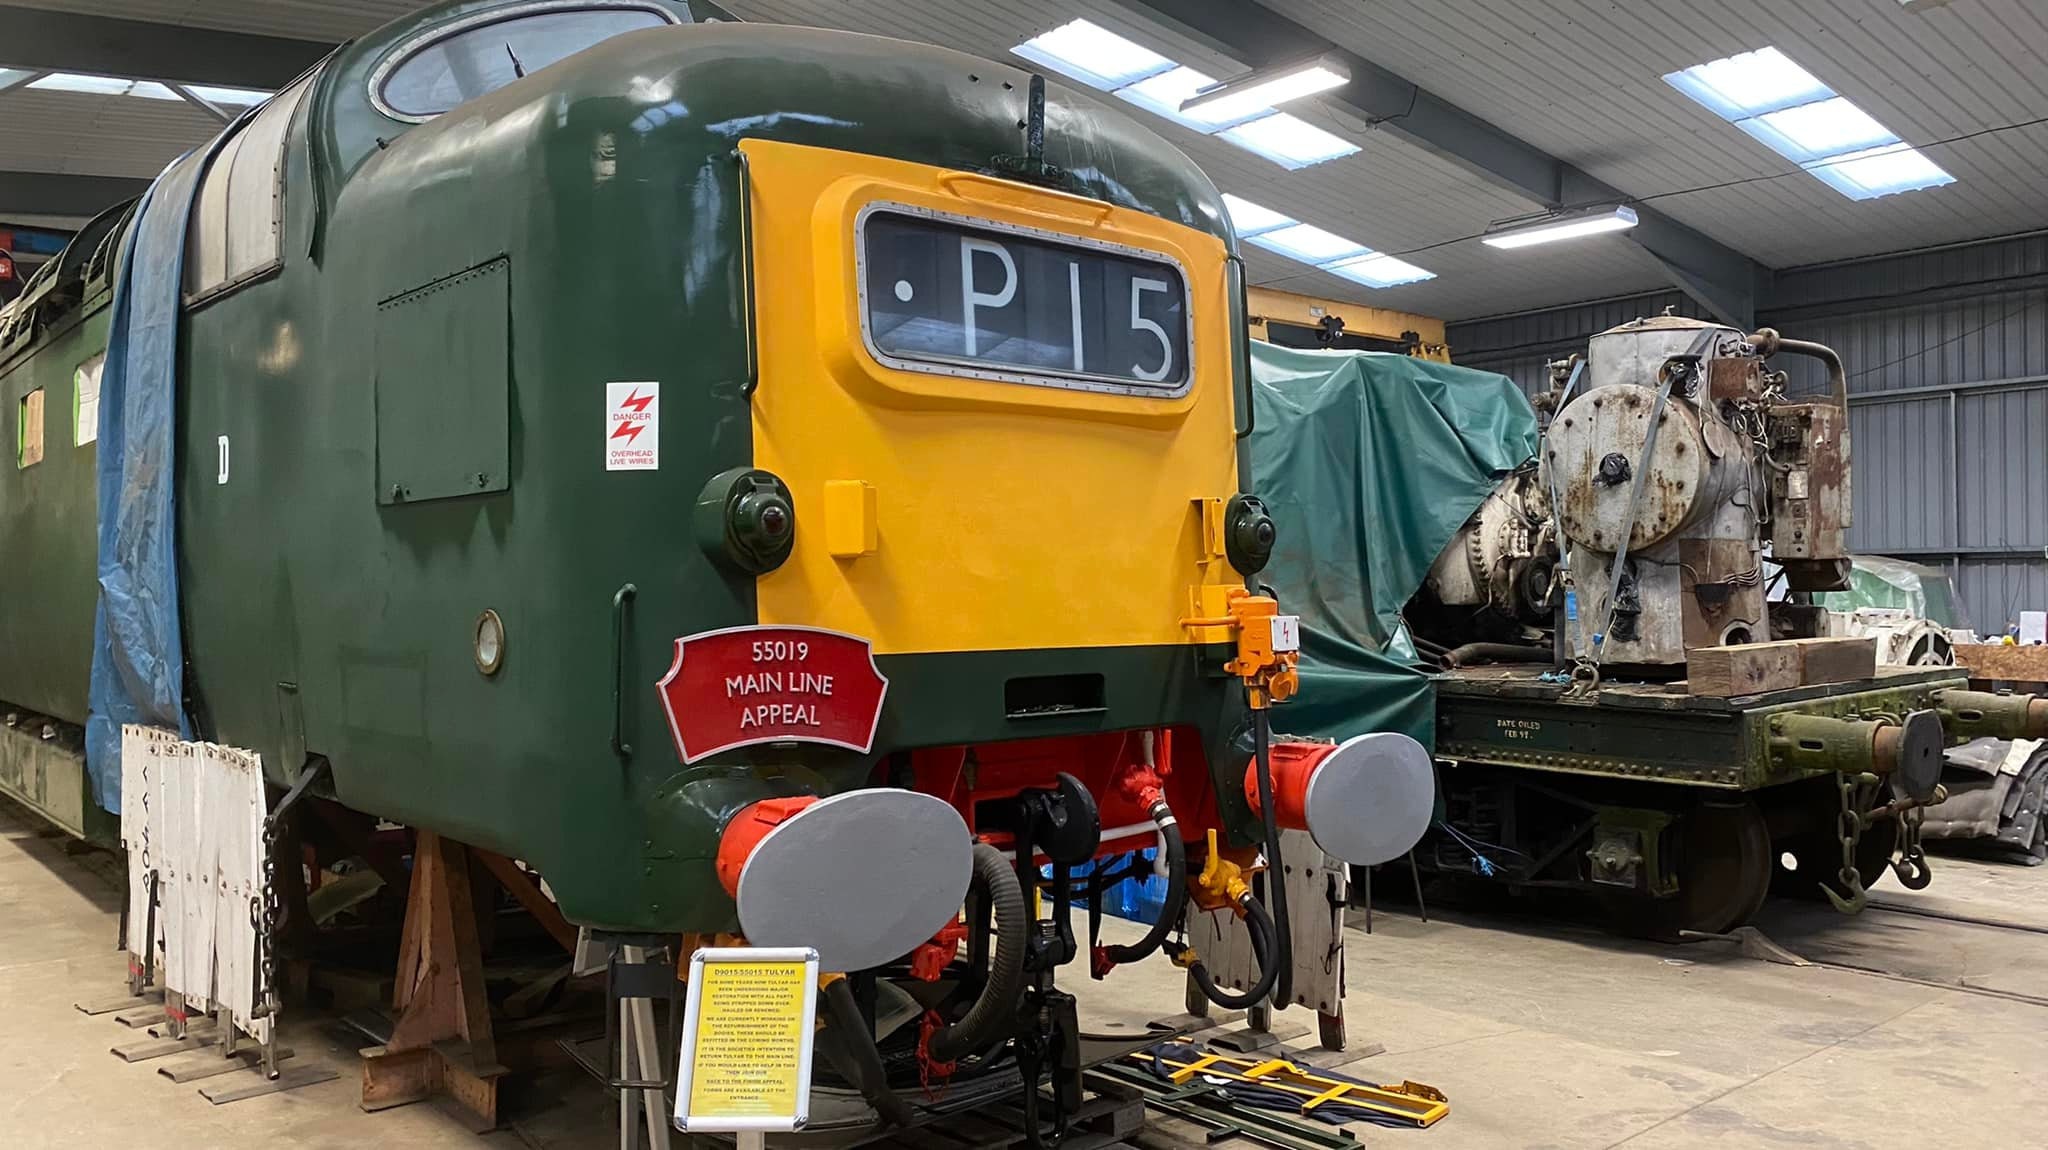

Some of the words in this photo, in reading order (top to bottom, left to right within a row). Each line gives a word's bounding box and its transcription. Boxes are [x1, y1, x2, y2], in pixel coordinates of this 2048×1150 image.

[613, 412, 652, 421] DANGER
[218, 435, 229, 484] D
[611, 450, 653, 458] OVERHEAD
[629, 457, 654, 465] WIRES
[752, 641, 808, 662] 55019
[725, 672, 782, 698] MAIN
[789, 672, 833, 696] LINE
[740, 704, 821, 729] APPEAL
